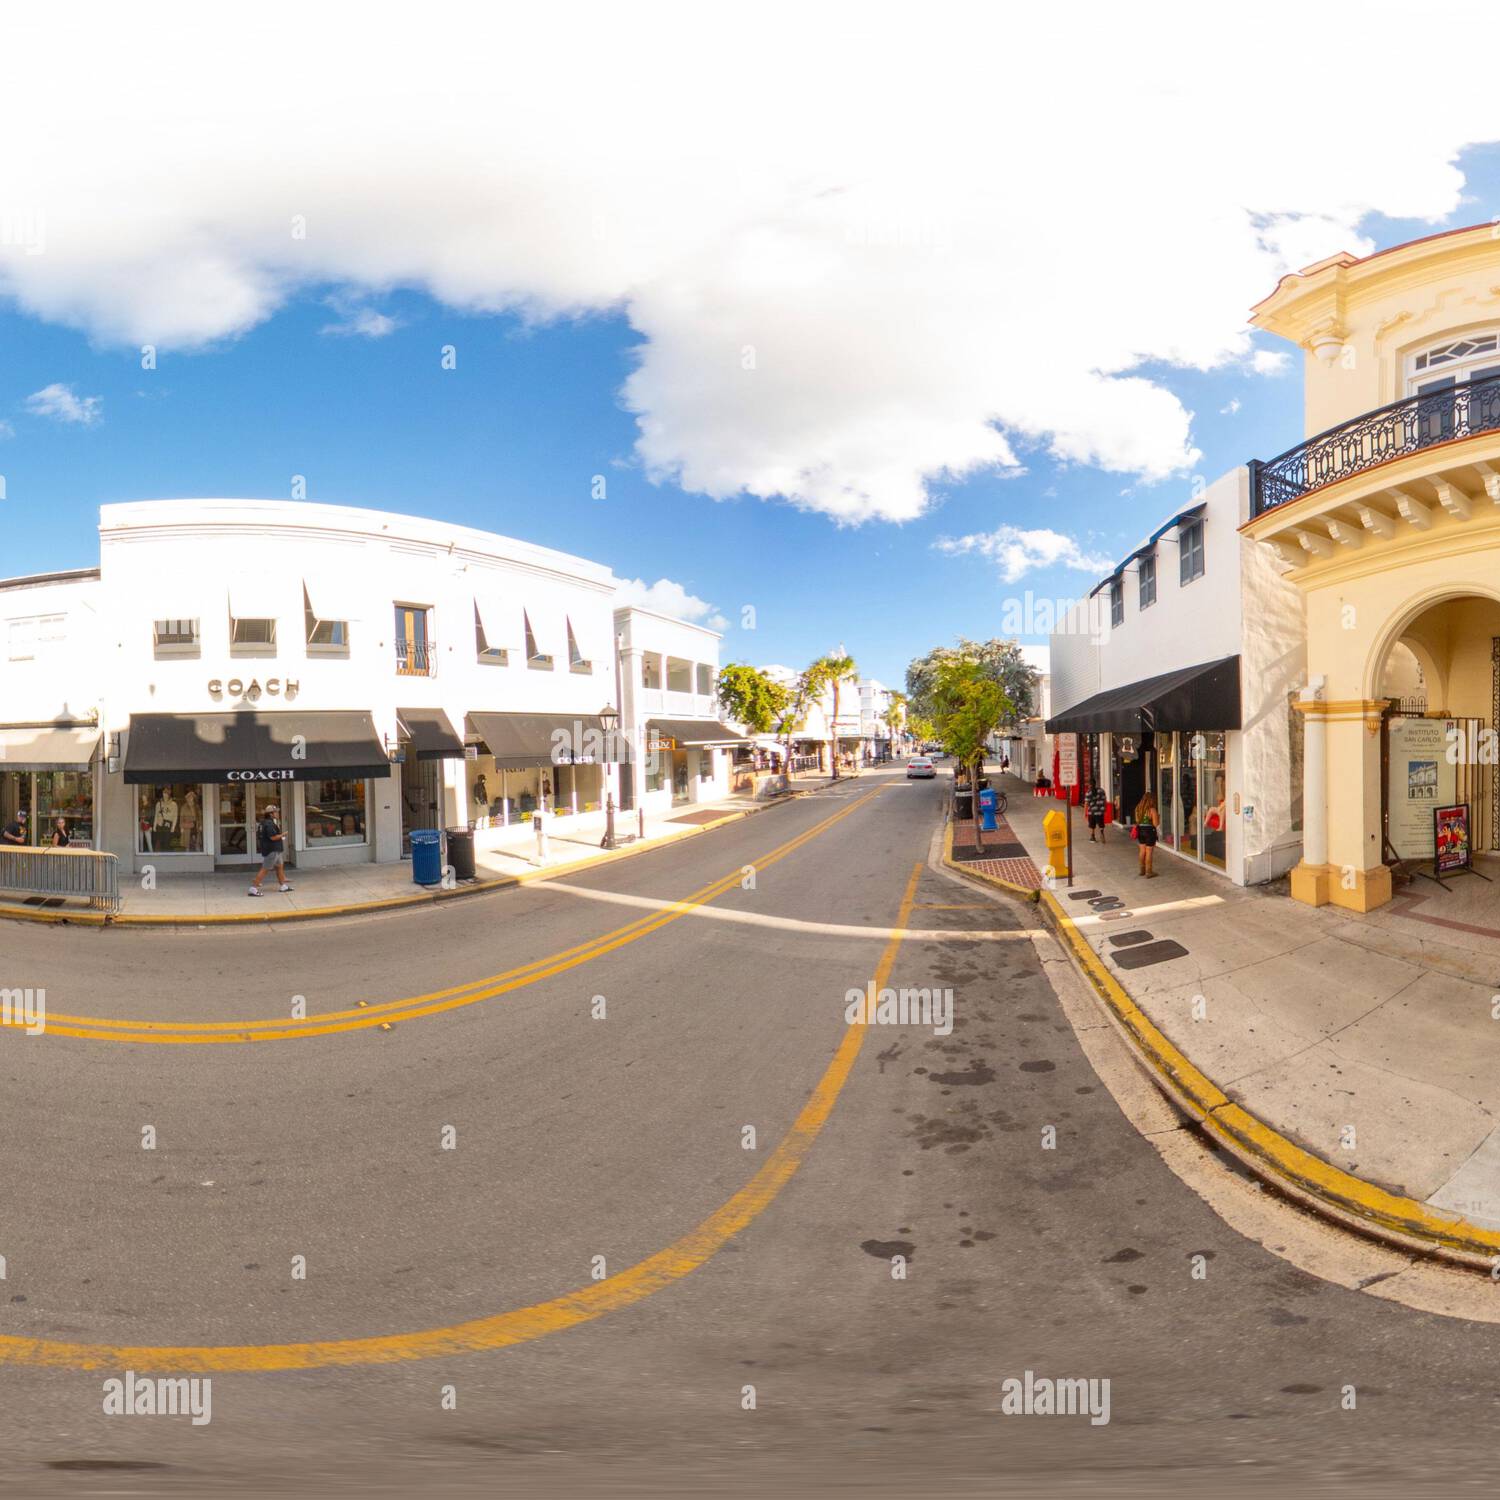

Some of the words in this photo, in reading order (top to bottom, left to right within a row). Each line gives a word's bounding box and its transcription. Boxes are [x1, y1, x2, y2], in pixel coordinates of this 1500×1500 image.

[208, 678, 299, 697] COACH
[557, 756, 594, 764] COACH
[226, 770, 295, 781] COACH
